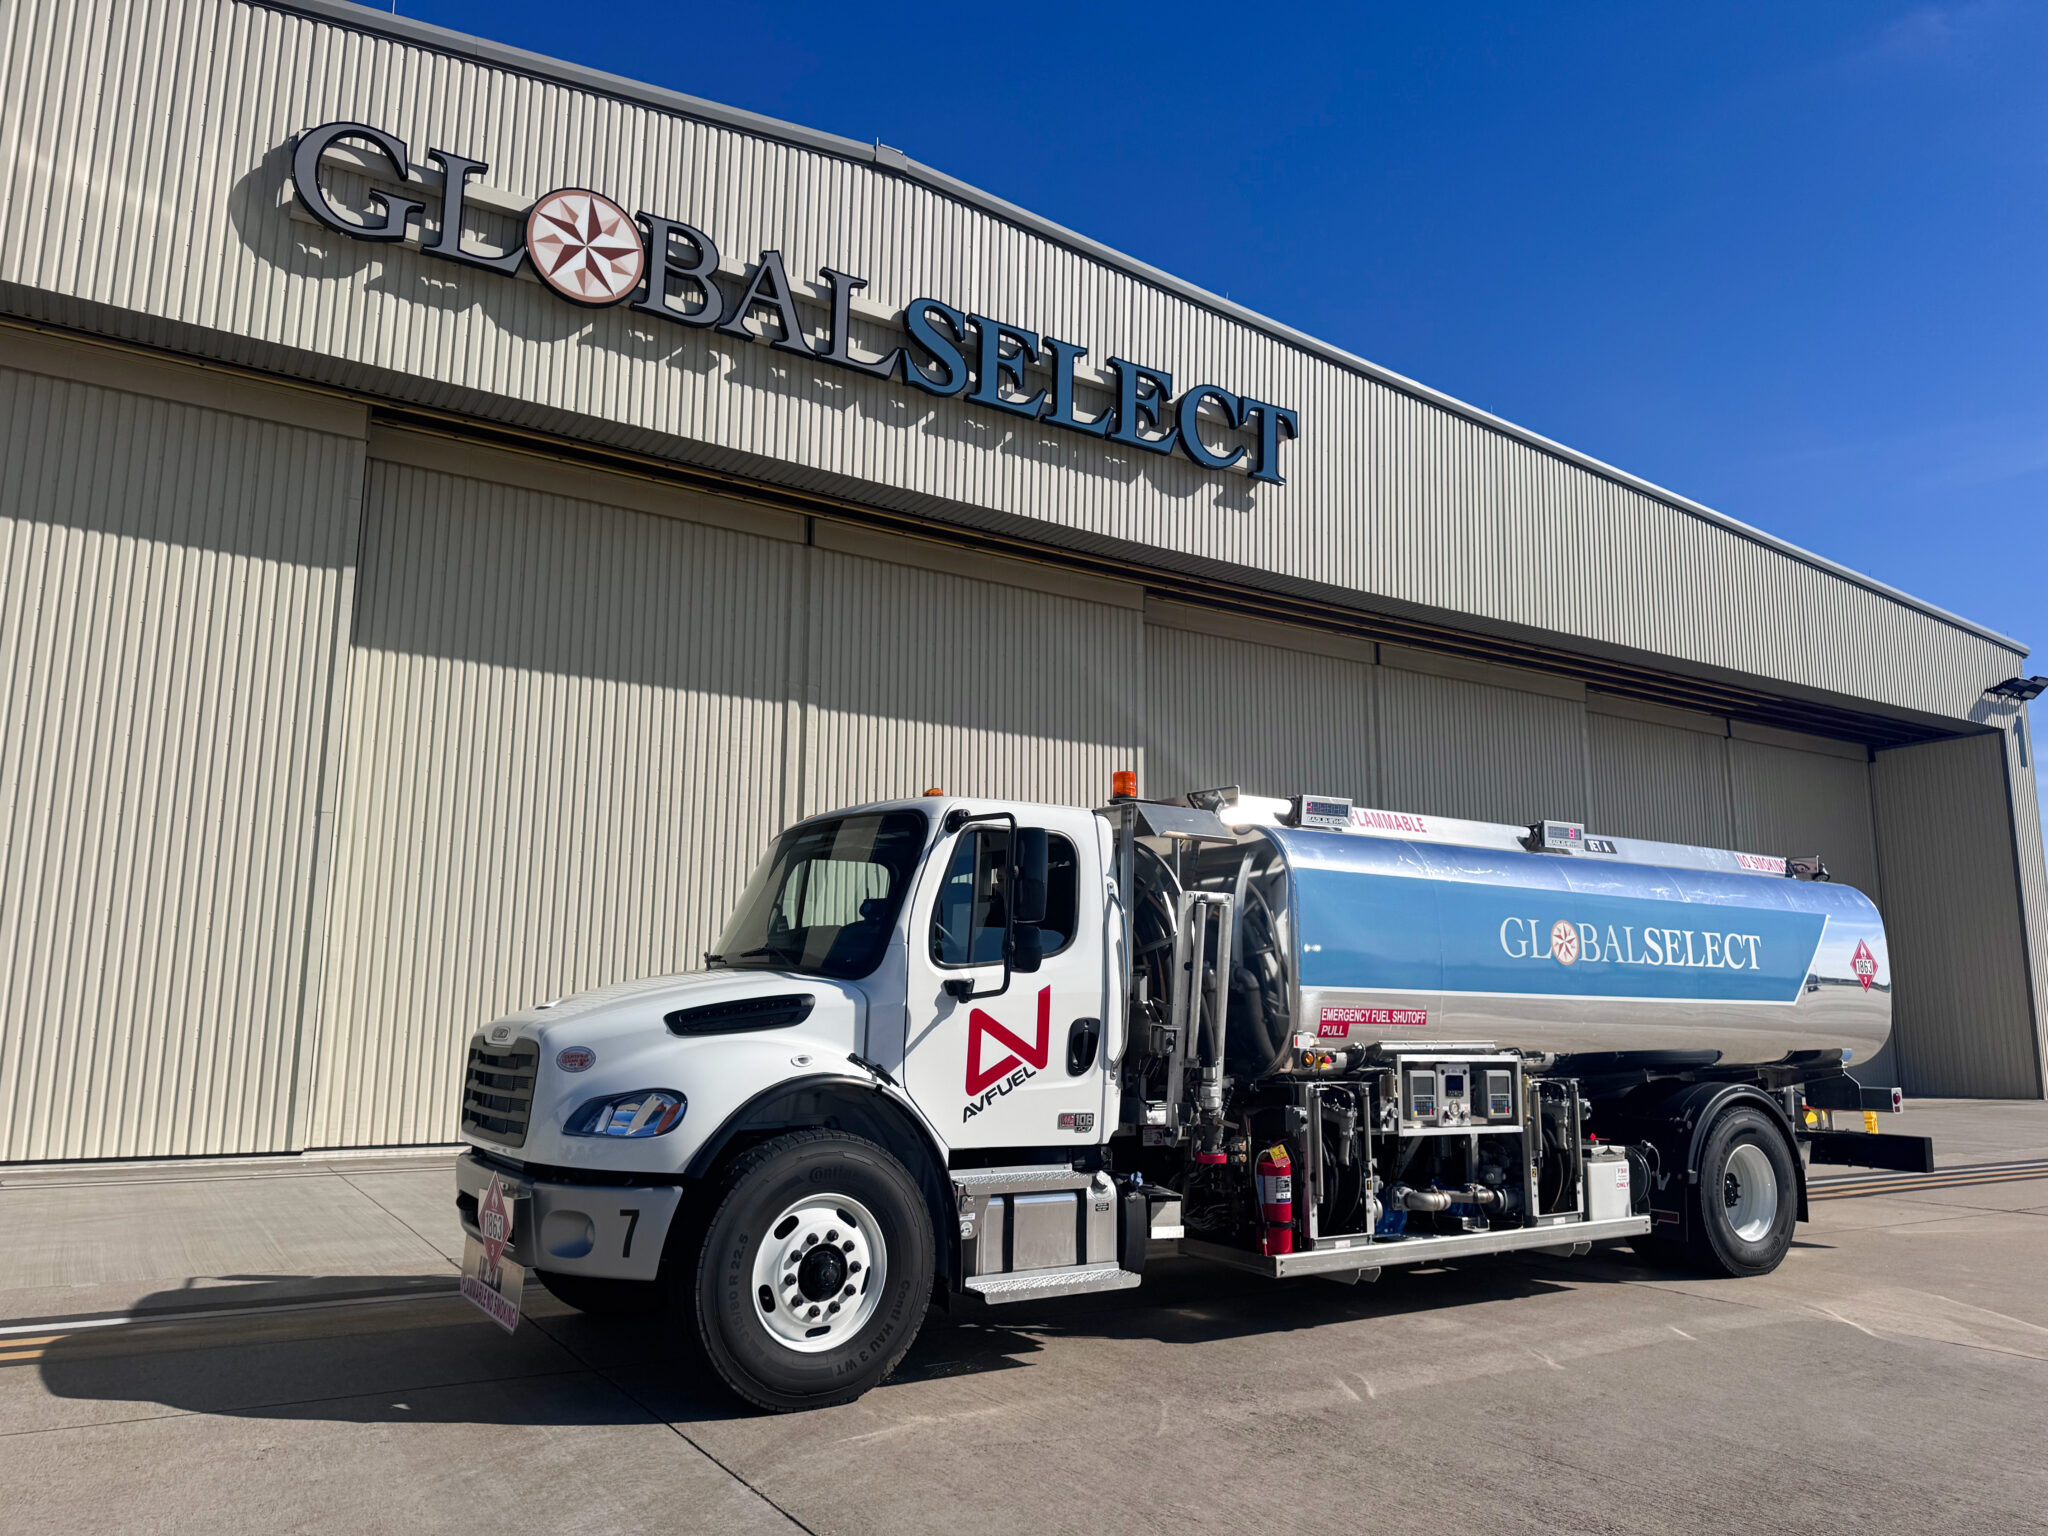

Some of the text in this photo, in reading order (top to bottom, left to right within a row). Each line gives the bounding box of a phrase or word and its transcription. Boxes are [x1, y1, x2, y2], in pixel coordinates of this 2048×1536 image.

[1736, 854, 1751, 869] NO
[1857, 960, 1872, 974] 1863
[1321, 1009, 1427, 1024] EMERGENCY FUEL SHUTOFF
[1320, 1025, 1345, 1036] PULL
[963, 1066, 1037, 1123] AVFUEL
[485, 1212, 502, 1241] 1863
[620, 1209, 640, 1258] 7
[491, 1244, 495, 1257] 3
[731, 1233, 749, 1270] 22.5
[729, 1275, 739, 1286] R
[493, 1295, 516, 1328] SMOKING
